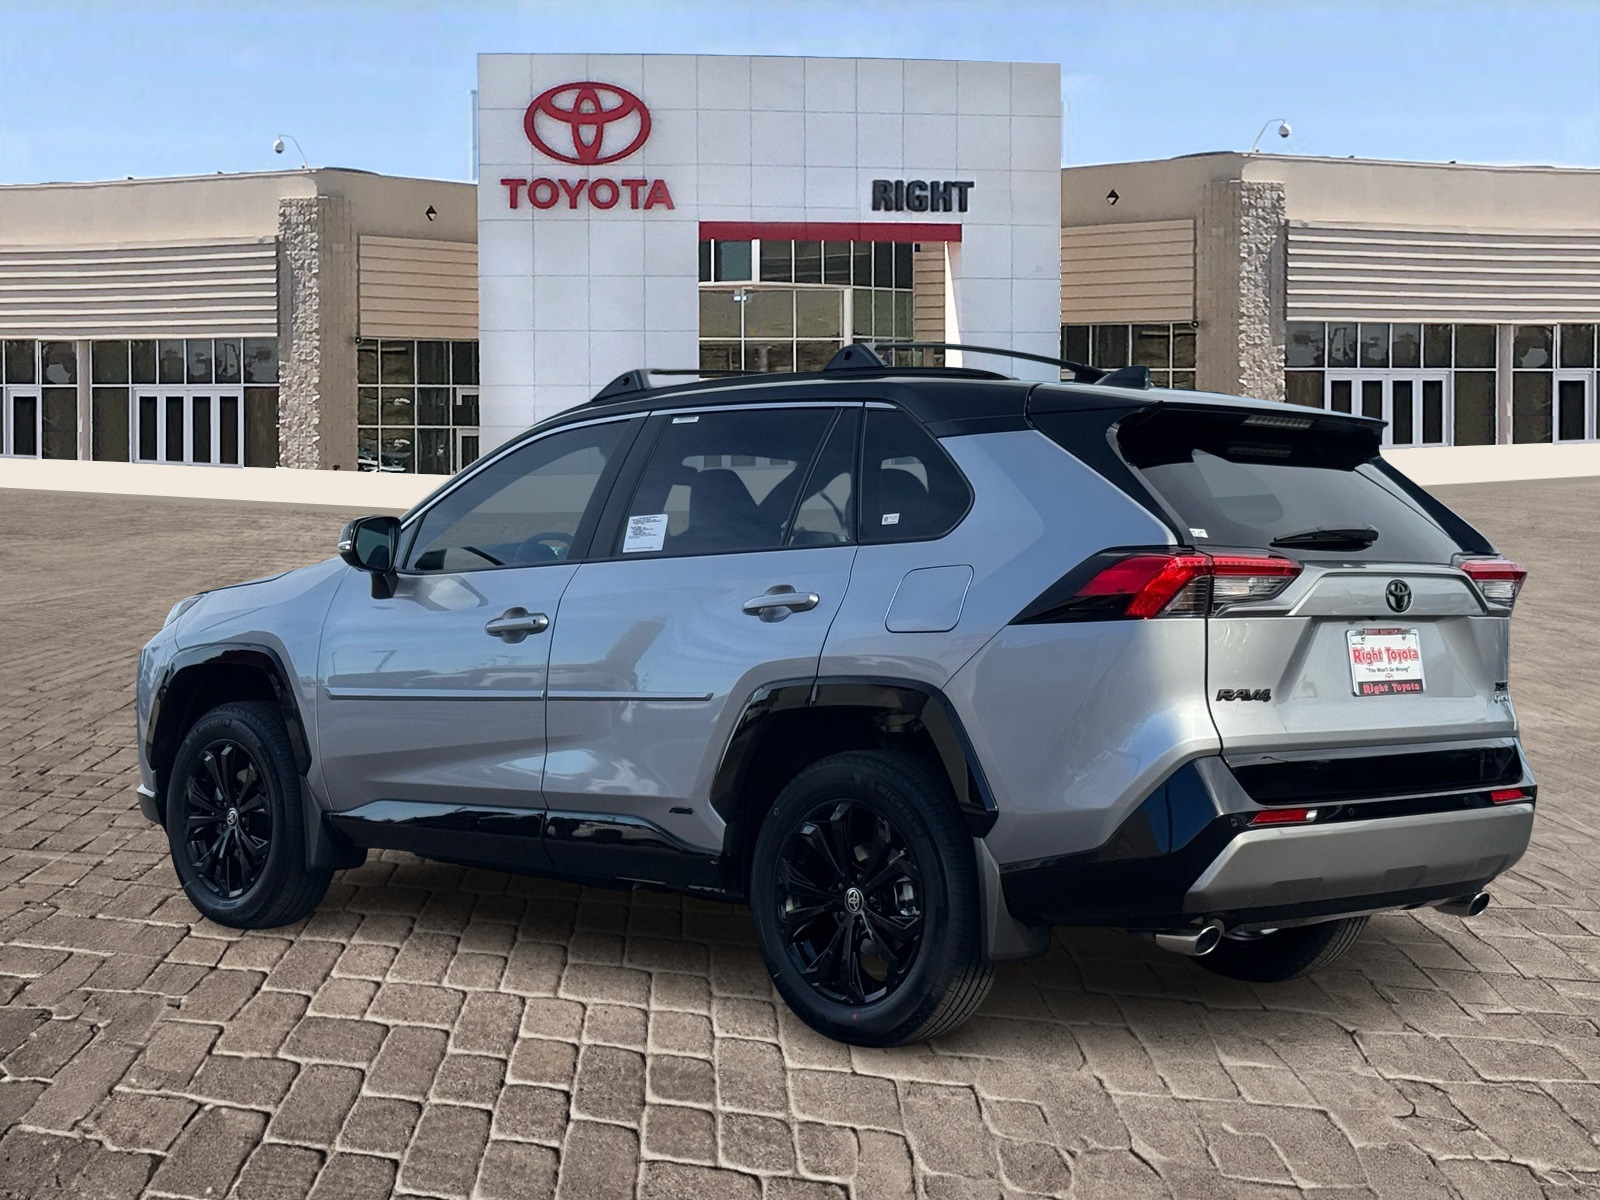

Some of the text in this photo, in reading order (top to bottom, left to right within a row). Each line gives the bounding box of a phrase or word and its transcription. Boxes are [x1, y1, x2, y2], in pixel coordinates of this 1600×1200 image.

[500, 178, 675, 210] TOYOTA
[872, 179, 976, 213] RIGHT
[1352, 646, 1419, 665] Right Toyota
[1216, 689, 1271, 702] RAV4
[1362, 682, 1420, 694] Right Toyota
